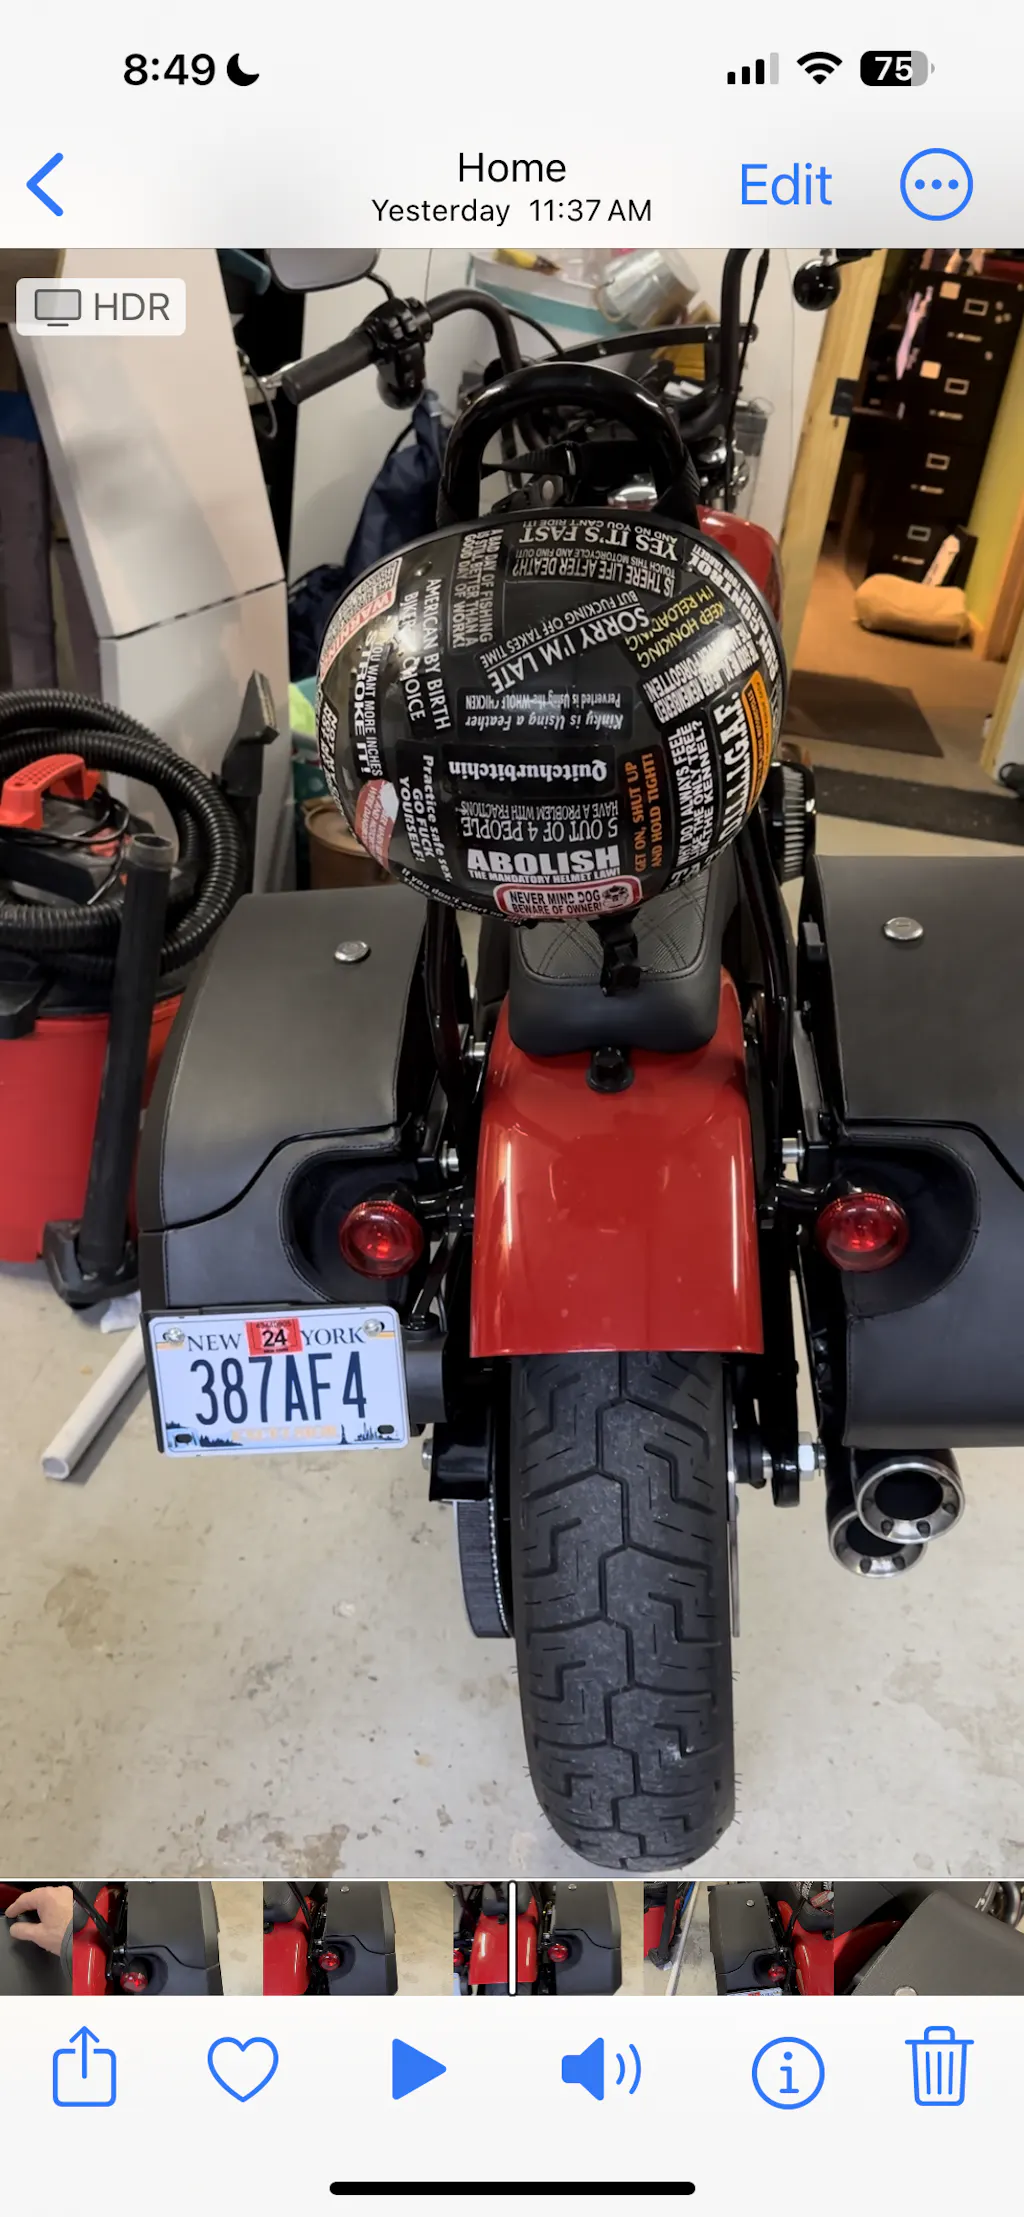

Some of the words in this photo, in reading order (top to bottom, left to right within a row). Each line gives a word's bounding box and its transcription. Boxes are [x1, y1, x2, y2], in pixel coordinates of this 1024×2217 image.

[519, 526, 579, 543] FAST
[584, 526, 629, 547] IT'S
[607, 521, 631, 532] YOU
[634, 526, 651, 536] NO
[654, 531, 678, 544] AND
[460, 534, 476, 559] GOOD
[472, 539, 487, 561] STILL
[536, 548, 555, 558] FIND
[556, 548, 573, 558] AND
[574, 548, 629, 564] MOTORCYCLE
[636, 534, 678, 561] YES
[457, 560, 470, 579] DAY
[483, 554, 498, 570] DAY
[512, 558, 557, 576] DEATH?
[559, 558, 598, 578] AFTER
[598, 560, 623, 582] LIFE
[631, 556, 648, 570] THIS
[650, 561, 675, 579] TOUCH
[454, 583, 466, 598] OF
[466, 561, 483, 599] BETTER
[481, 574, 495, 587] OF
[625, 565, 660, 594] THERE
[664, 577, 674, 598] IS
[617, 590, 638, 604] BUT
[688, 552, 760, 635] CONTROL
[696, 585, 714, 603] I'M
[423, 579, 442, 650] AMERICAN
[465, 600, 479, 633] THAN
[479, 590, 493, 642] FISHING
[565, 597, 616, 624] FUCKING
[699, 601, 725, 625] KEEP
[453, 601, 466, 648] WORK!
[543, 617, 563, 632] OFF
[580, 608, 650, 649] SORRY
[466, 637, 478, 647] A
[506, 626, 542, 653] TAKES
[539, 634, 576, 665] I'M
[637, 617, 699, 668] HONKING
[424, 652, 441, 673] BY
[480, 645, 507, 668] TIME
[354, 630, 377, 736] STROKE
[365, 666, 379, 697] WANT
[487, 652, 539, 694] LATE
[400, 656, 426, 721] CHOICE
[426, 678, 451, 730] BIRTH
[465, 694, 500, 710] CHICKEN
[572, 693, 580, 708] is
[581, 693, 620, 708] Perverted
[364, 700, 376, 734] MORE
[465, 714, 512, 731] Feather
[516, 715, 524, 726] a
[528, 712, 565, 730] Using
[570, 715, 581, 730] is
[586, 710, 624, 730] Kinky
[668, 728, 687, 766] FEEL
[680, 722, 698, 766] TREE
[356, 742, 371, 773] IT!
[366, 737, 383, 777] INCHES
[692, 720, 714, 804] KENNEL?
[448, 759, 607, 783] Quitchurbitchin
[625, 762, 639, 783] UP
[642, 752, 659, 803] TIGHT!
[676, 766, 694, 817] ALWAYS
[690, 768, 703, 805] ONLY
[412, 788, 425, 814] GO
[511, 802, 535, 820] WITH
[582, 803, 590, 819] A
[592, 800, 619, 817] HAVE
[629, 787, 644, 824] SHUT
[399, 776, 425, 862] YOURSELF!
[423, 755, 437, 823] Practice
[430, 826, 445, 856] safe
[438, 858, 453, 882] sex.
[536, 804, 581, 821] PROBLEM
[650, 805, 662, 842] HOLD
[693, 806, 704, 835] THE
[700, 805, 714, 838] THE
[416, 816, 435, 858] FUCK
[461, 817, 524, 841] PEOPLE
[528, 821, 539, 842] 4
[543, 821, 564, 842] OF
[569, 818, 603, 842] OUT
[608, 817, 618, 838] 5
[680, 825, 693, 843] DO
[468, 845, 620, 875] ABOLISH
[635, 854, 647, 872] GET
[651, 845, 663, 868] AND
[411, 876, 430, 890] you
[468, 869, 487, 880] THE
[489, 871, 551, 884] MANDATORY
[553, 873, 591, 883] HELMET
[594, 868, 620, 880] LAW!
[509, 891, 545, 905] NEVER
[548, 892, 574, 905] MIND
[579, 890, 600, 903] DOG
[512, 903, 550, 915] BEWARE
[552, 904, 564, 915] OF
[566, 901, 601, 914] OWNER!
[187, 1333, 243, 1352] NEW
[300, 1327, 366, 1346] YORK
[262, 1328, 288, 1347] 24
[190, 1351, 368, 1425] 387AF4
